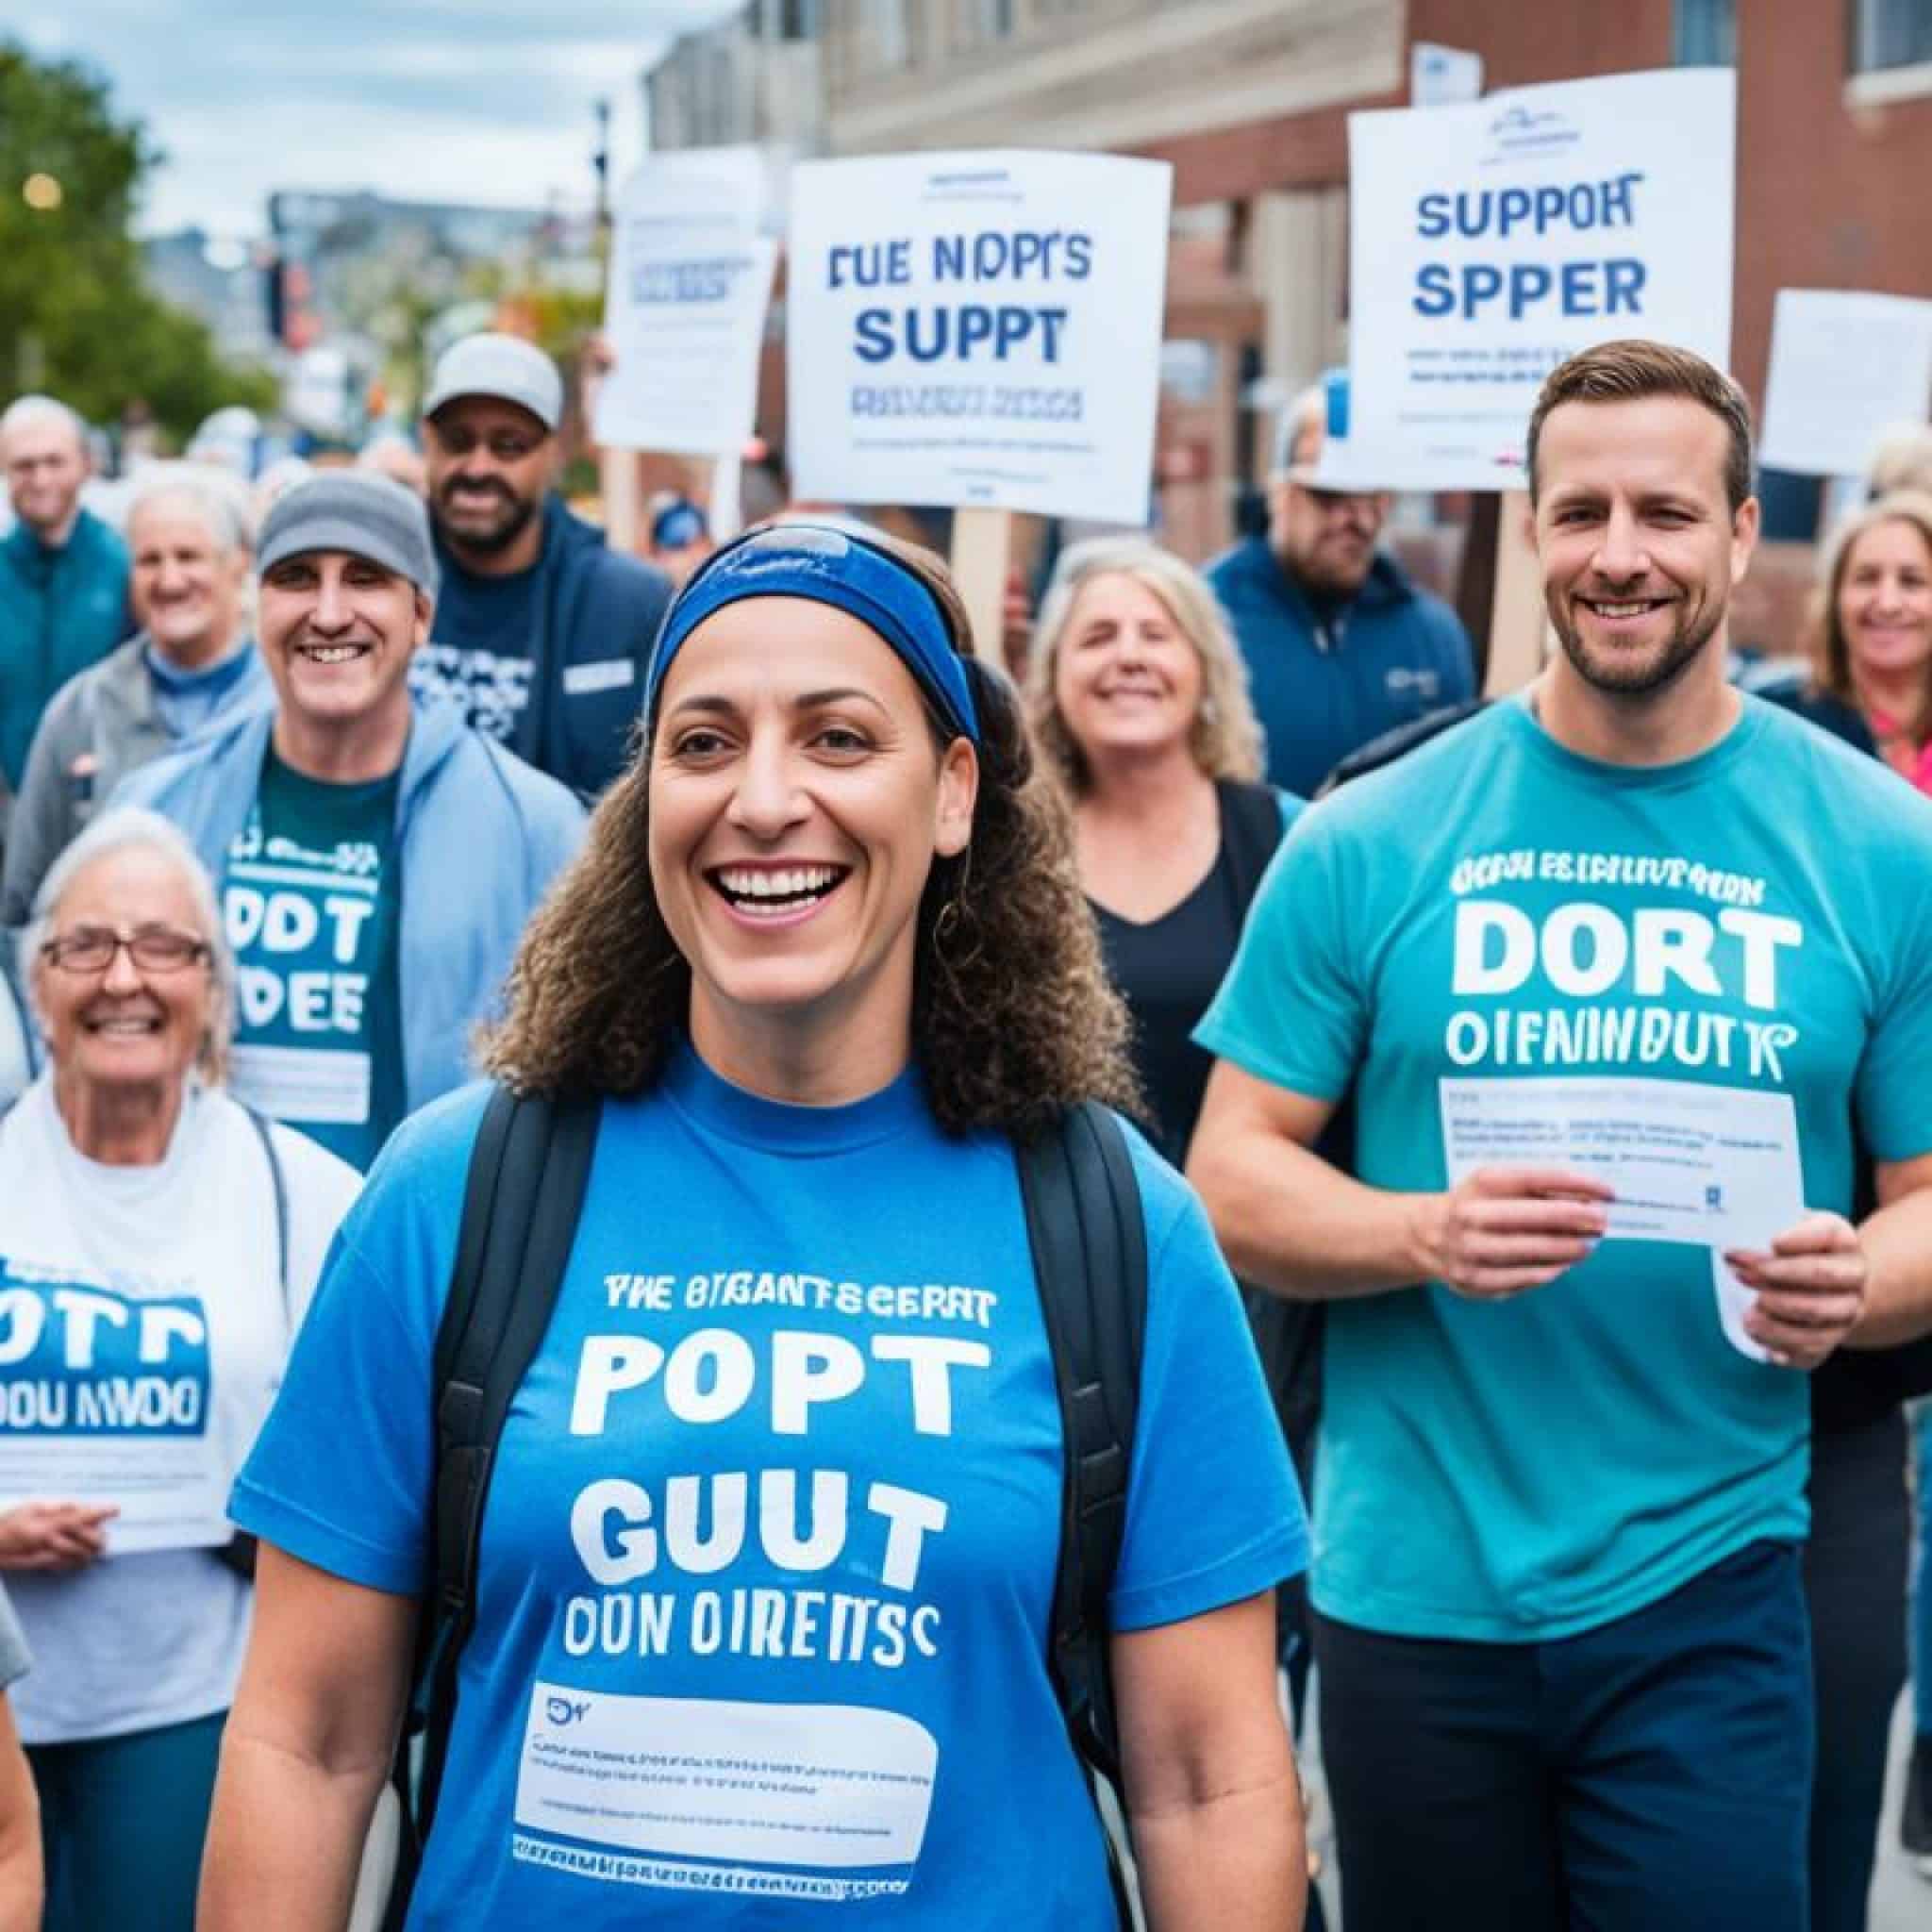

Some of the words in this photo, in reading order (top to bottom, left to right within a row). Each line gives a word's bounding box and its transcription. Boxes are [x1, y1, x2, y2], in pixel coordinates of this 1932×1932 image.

[852, 303, 1069, 365] SUPPT
[1411, 258, 1648, 323] SPPER
[1452, 900, 1804, 1011] DORT
[569, 1328, 991, 1436] POPT
[570, 1469, 948, 1591] GUUT
